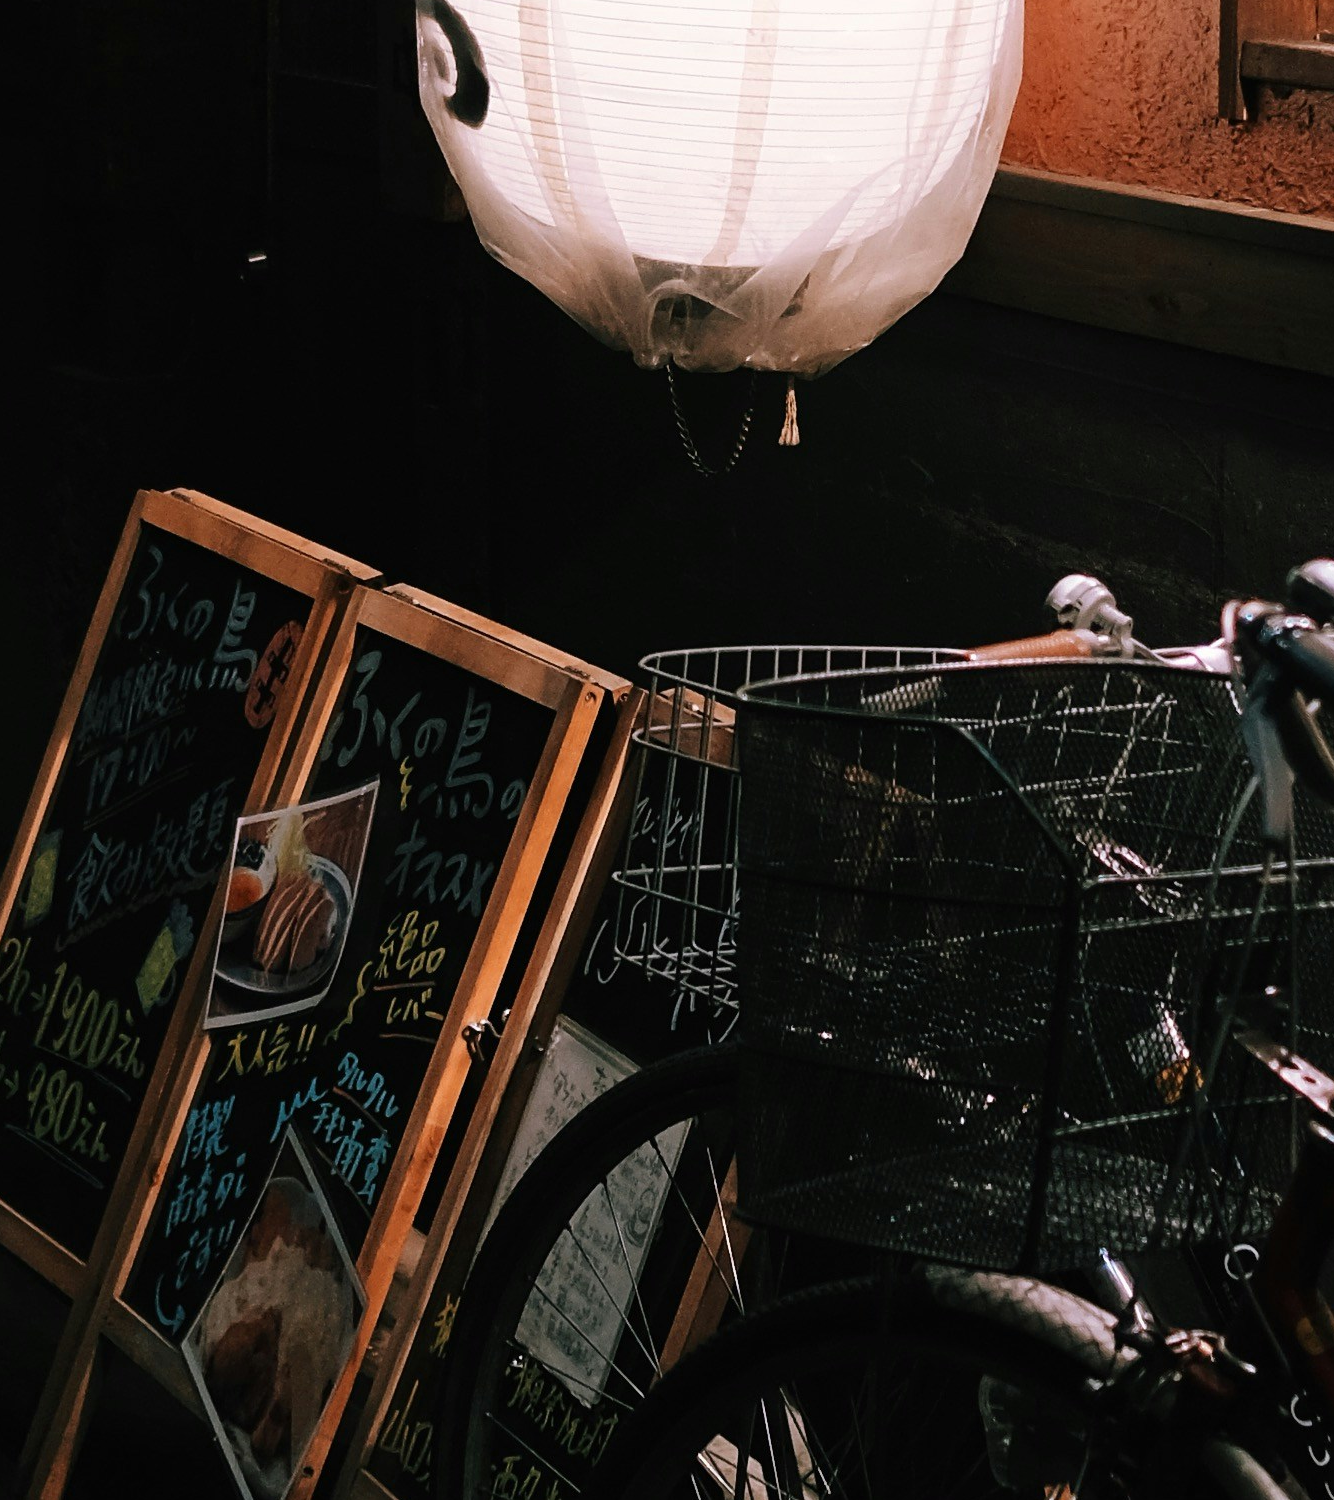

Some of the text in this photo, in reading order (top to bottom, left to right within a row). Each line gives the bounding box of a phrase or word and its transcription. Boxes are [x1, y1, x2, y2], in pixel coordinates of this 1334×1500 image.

[116, 544, 259, 693] ふくの鳥
[66, 776, 236, 930] 飲み放題
[384, 818, 495, 919] オススメ
[374, 909, 445, 980] 絶品
[385, 986, 444, 1025] レバー
[336, 1050, 401, 1119] タルタル
